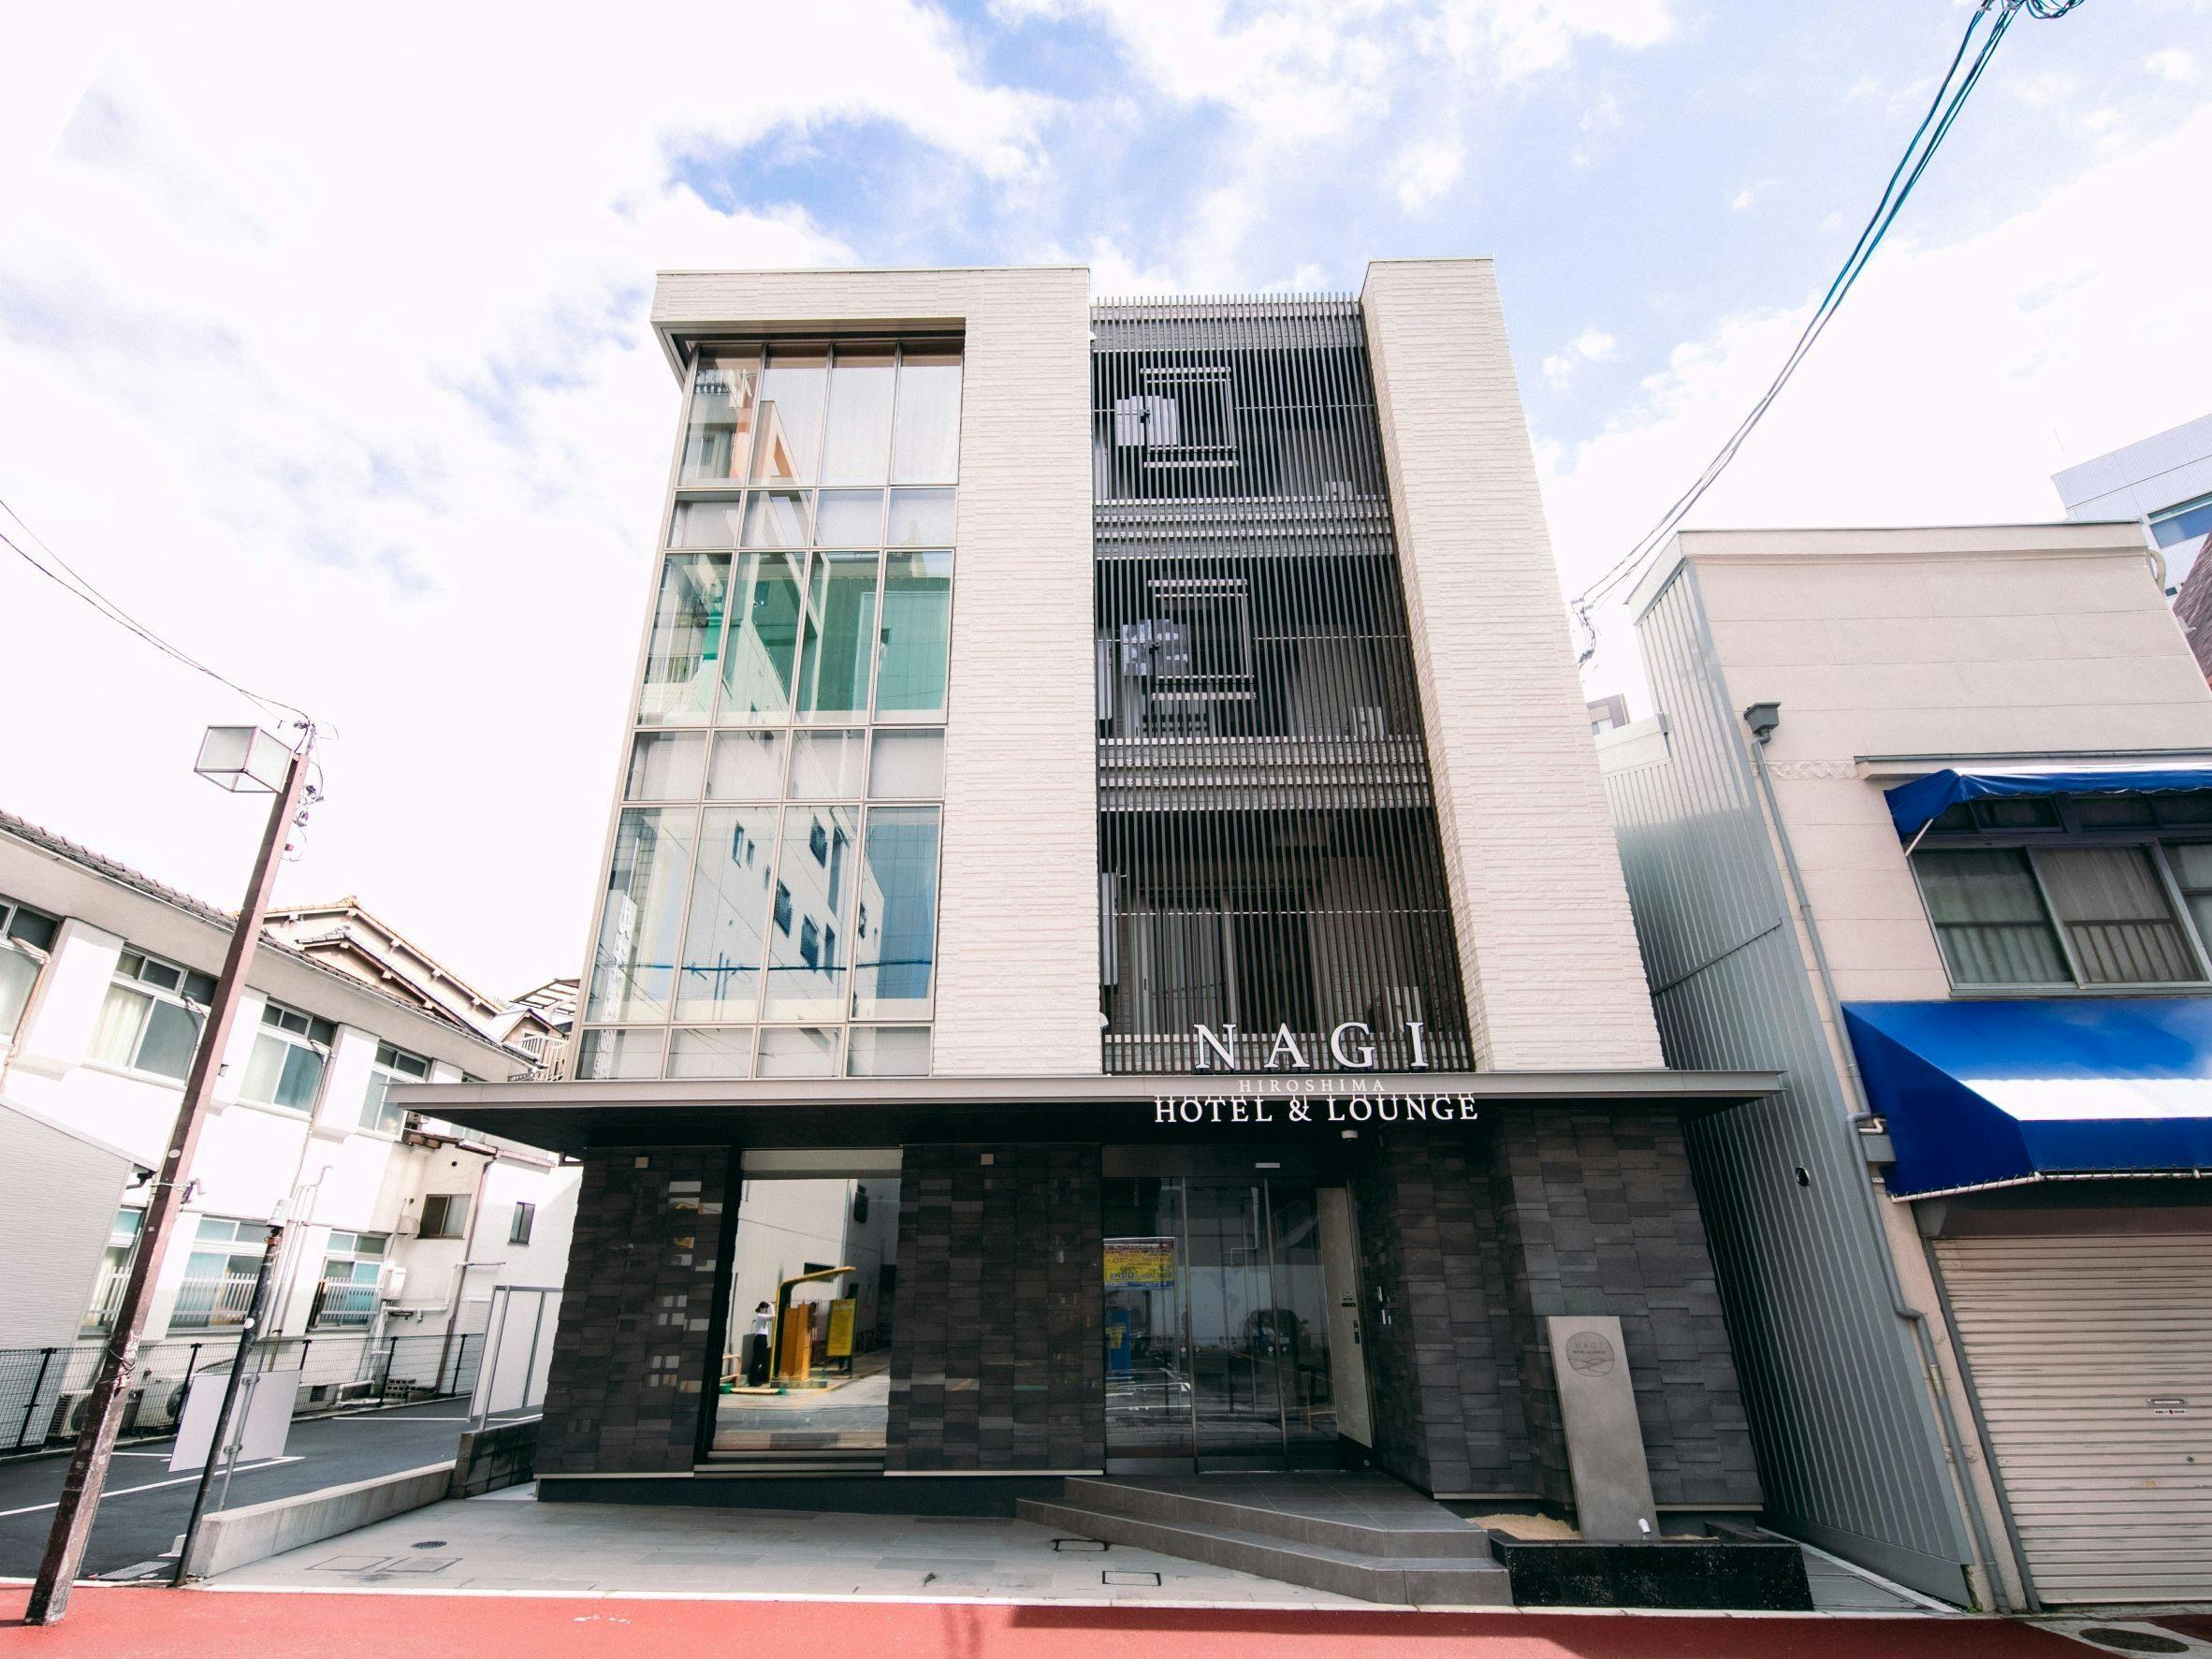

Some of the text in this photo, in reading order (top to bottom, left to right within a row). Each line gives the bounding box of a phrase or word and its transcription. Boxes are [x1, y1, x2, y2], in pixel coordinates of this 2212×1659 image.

[1193, 1021, 1429, 1070] NAGI
[1239, 1079, 1385, 1093] HIROSHIMA
[1155, 1097, 1478, 1123] HOTEL & LOUNGE
